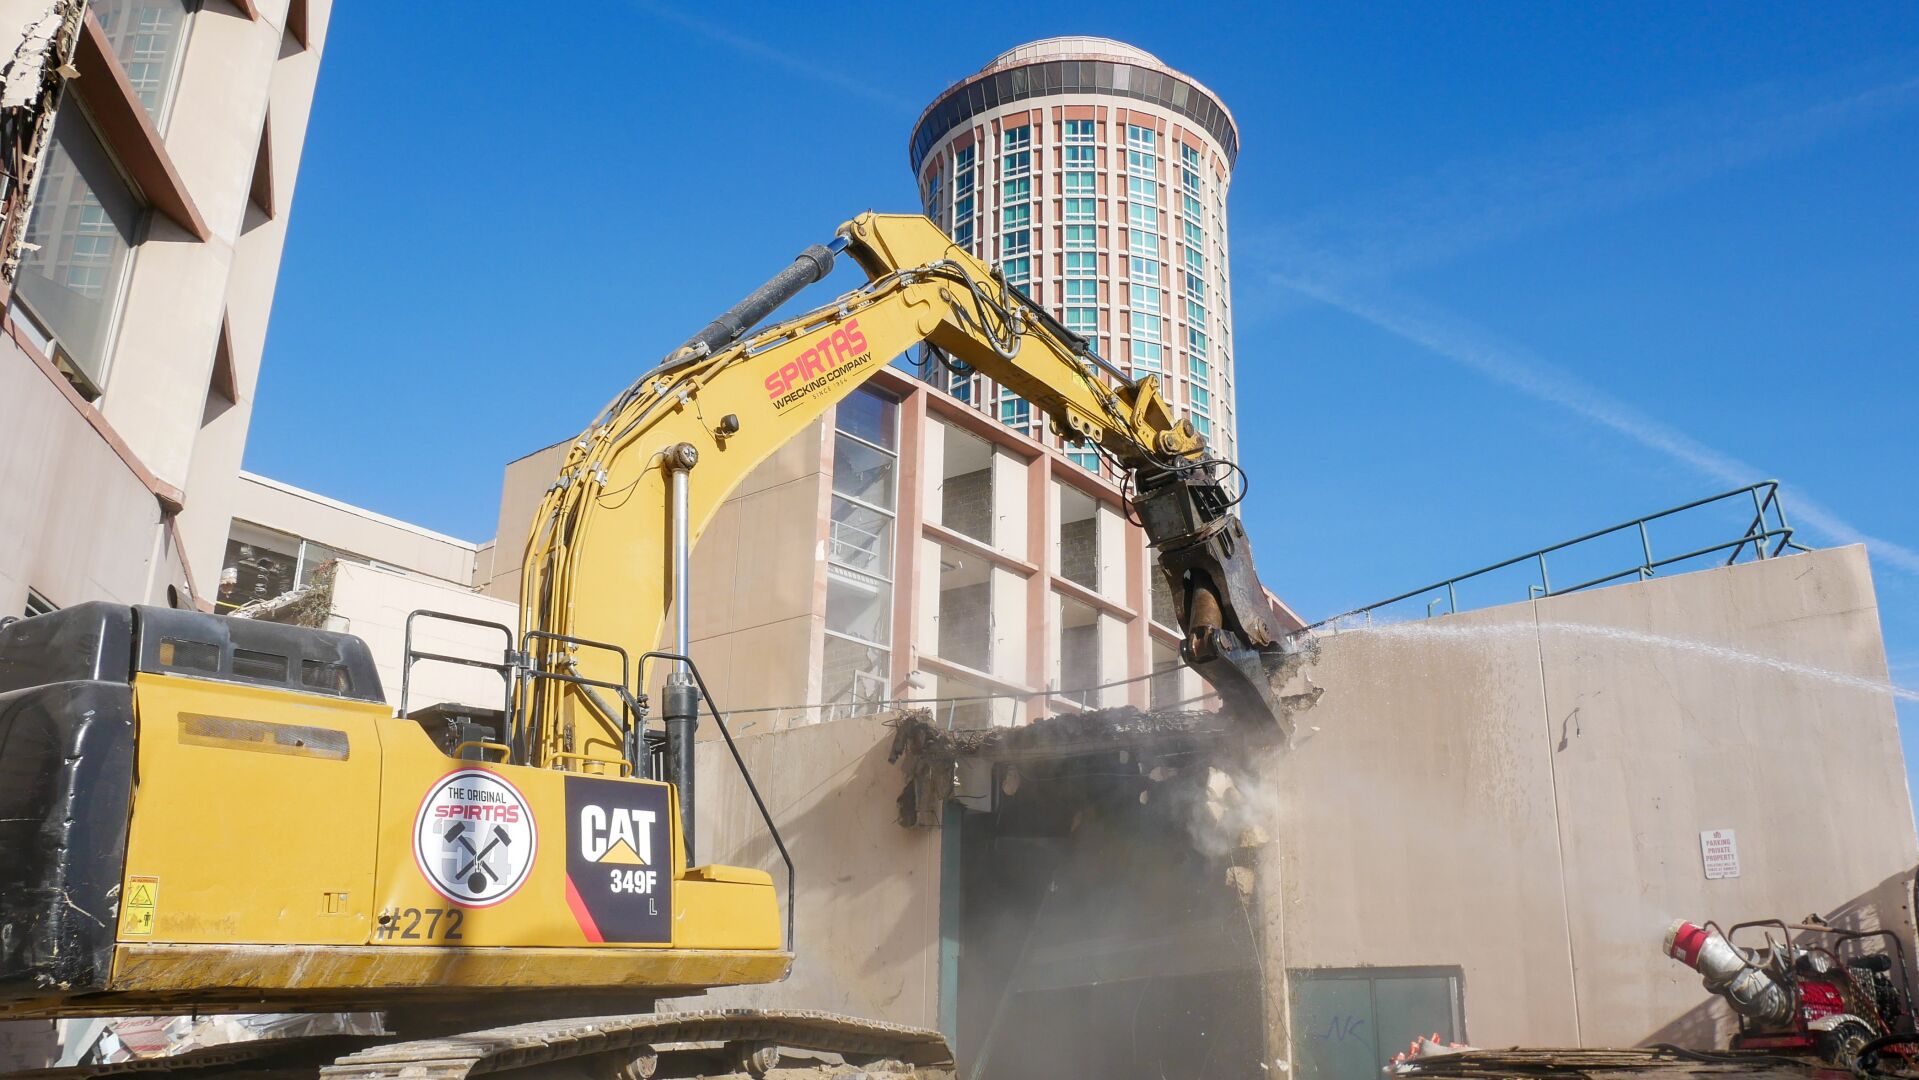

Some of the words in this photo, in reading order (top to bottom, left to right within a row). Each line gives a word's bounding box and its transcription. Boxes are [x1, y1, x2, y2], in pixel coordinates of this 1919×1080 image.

[764, 318, 868, 400] SPIRTAS
[772, 376, 827, 410] WRECKING
[826, 351, 873, 382] COMPANY
[812, 387, 832, 400] SINCE
[448, 787, 465, 800] THE
[467, 788, 507, 804] ORIGINAL
[435, 804, 520, 823] SPIRTAS
[580, 804, 656, 865] CAT
[1706, 839, 1731, 847] PARKING
[1707, 846, 1731, 854] PRIVATE
[610, 869, 657, 894] 349F
[649, 898, 657, 917] L
[377, 907, 464, 939] #272
